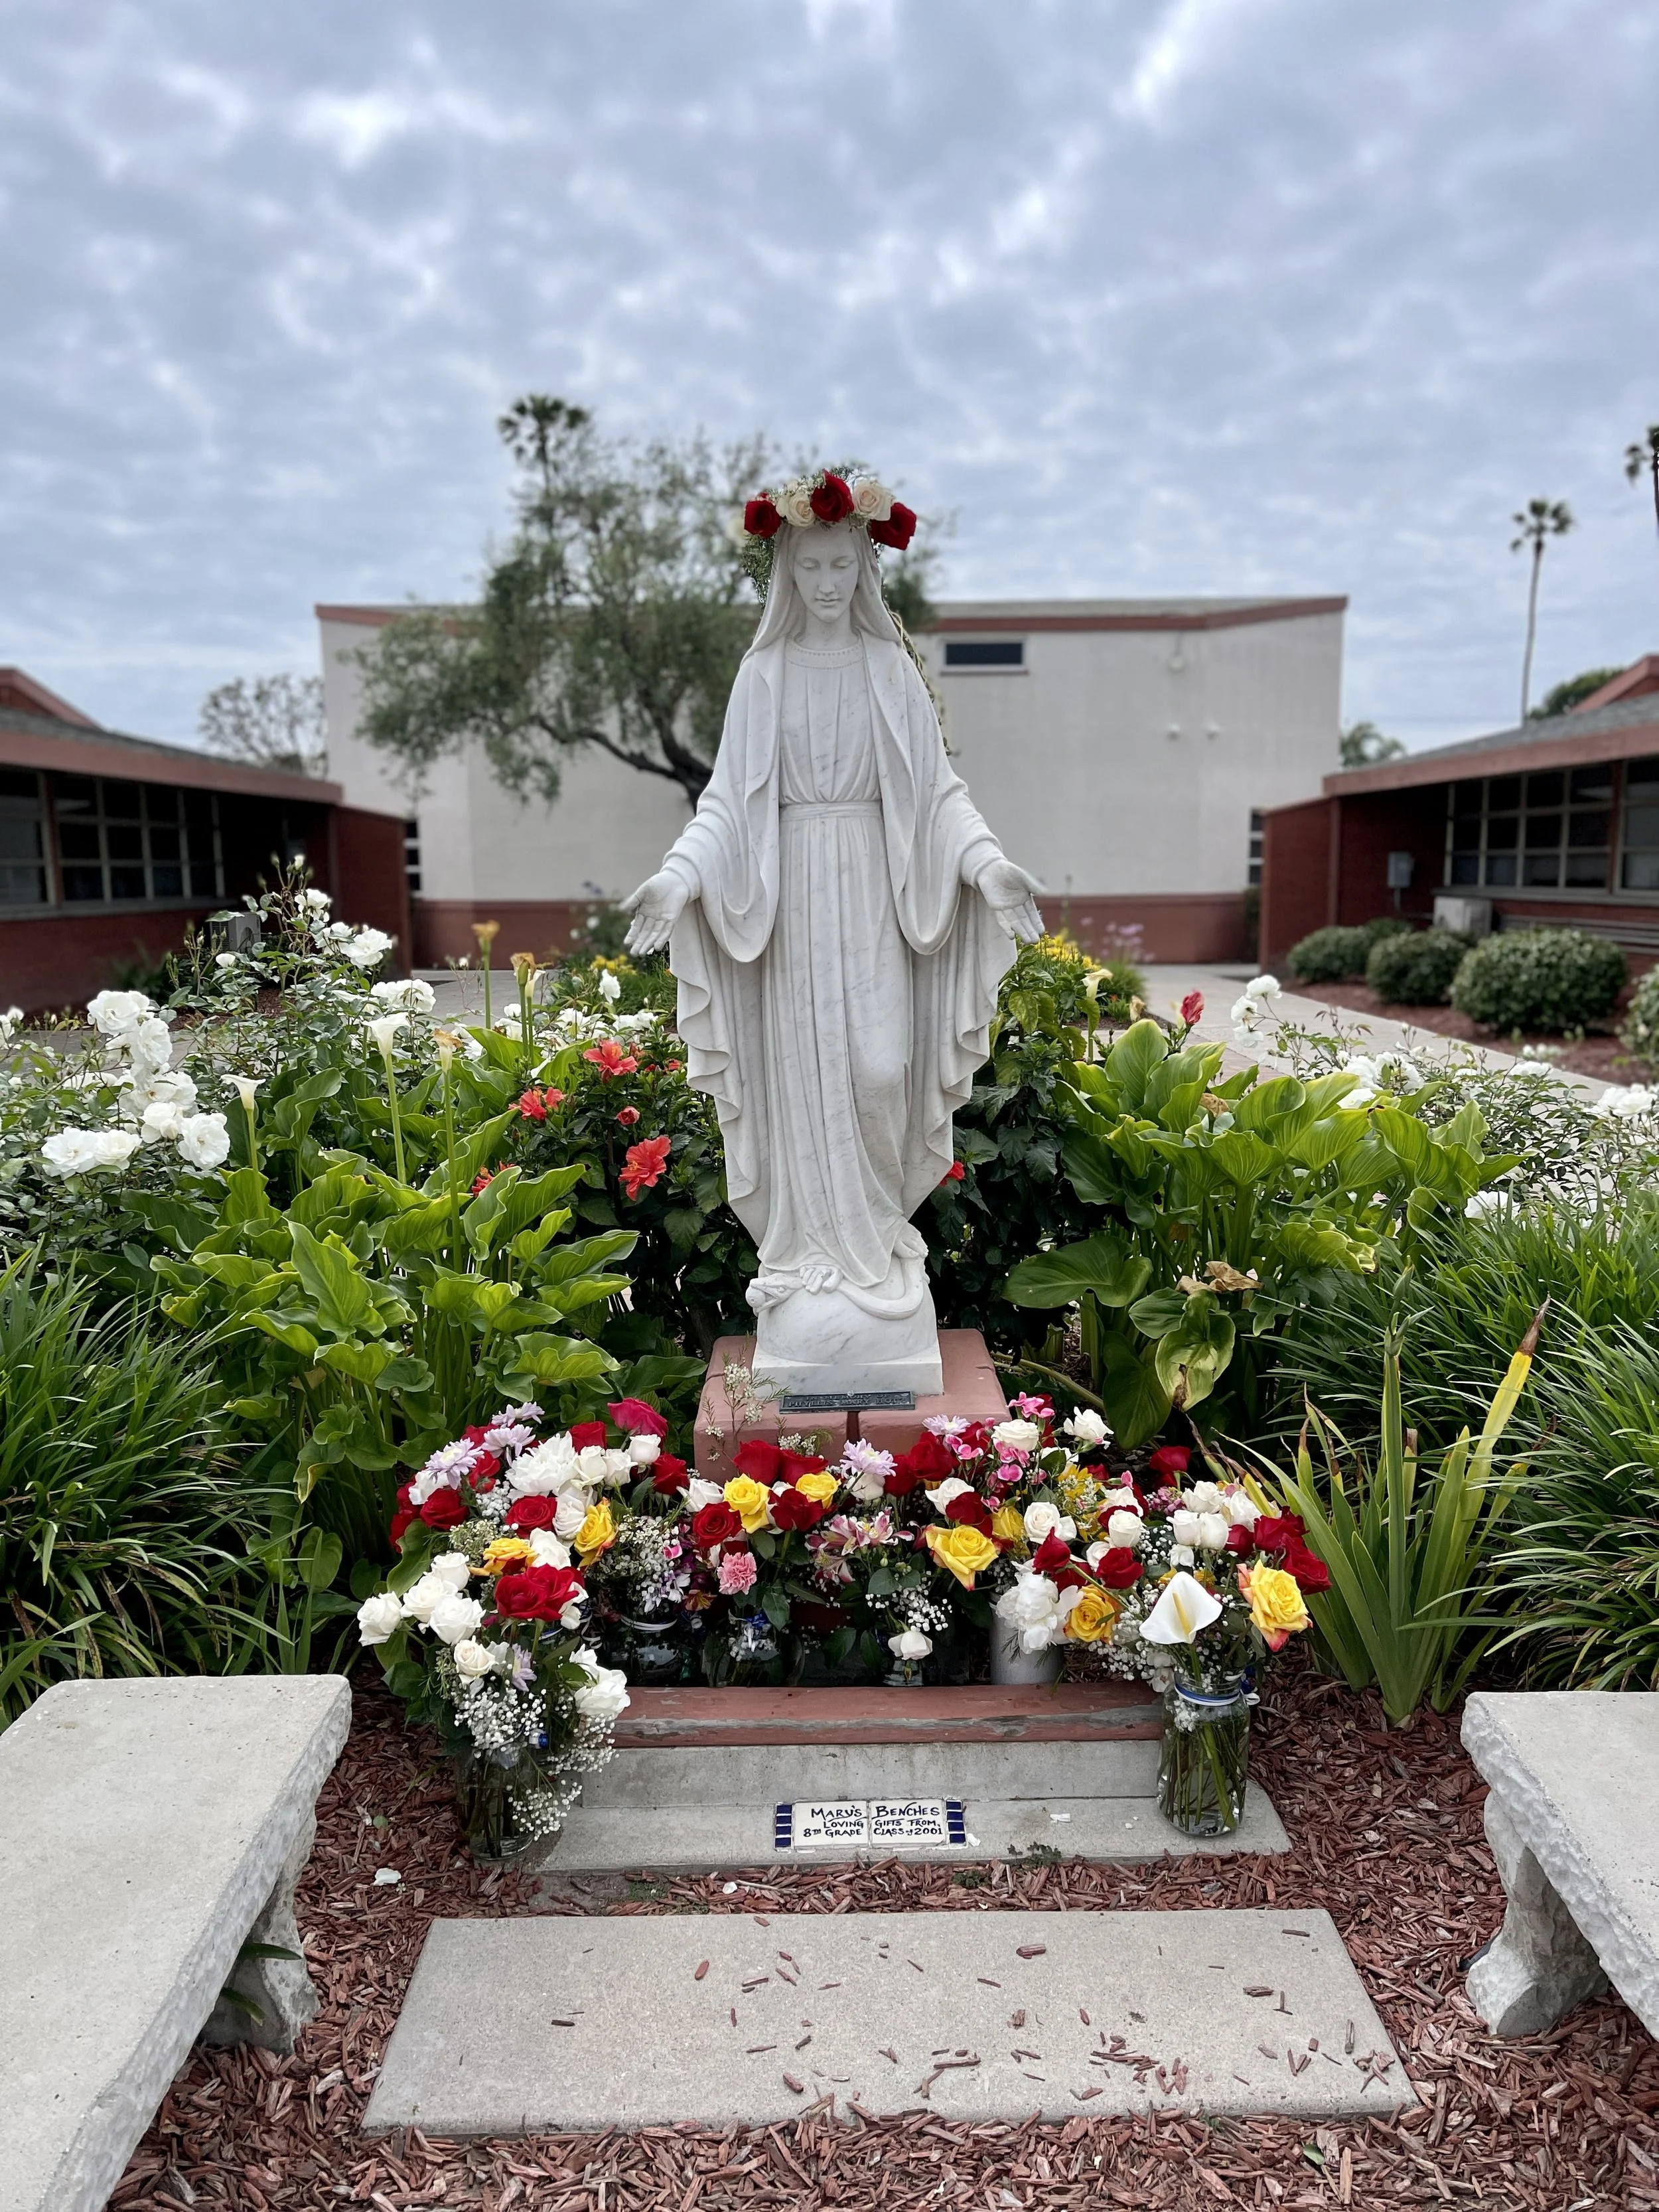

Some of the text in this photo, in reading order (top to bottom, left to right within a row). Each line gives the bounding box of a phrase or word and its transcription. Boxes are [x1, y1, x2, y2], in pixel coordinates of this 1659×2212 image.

[872, 1802, 940, 1819] BENCHES
[875, 1818, 904, 1828] GIFTS
[825, 1828, 862, 1838] GRADE
[873, 1828, 904, 1836] CLASS
